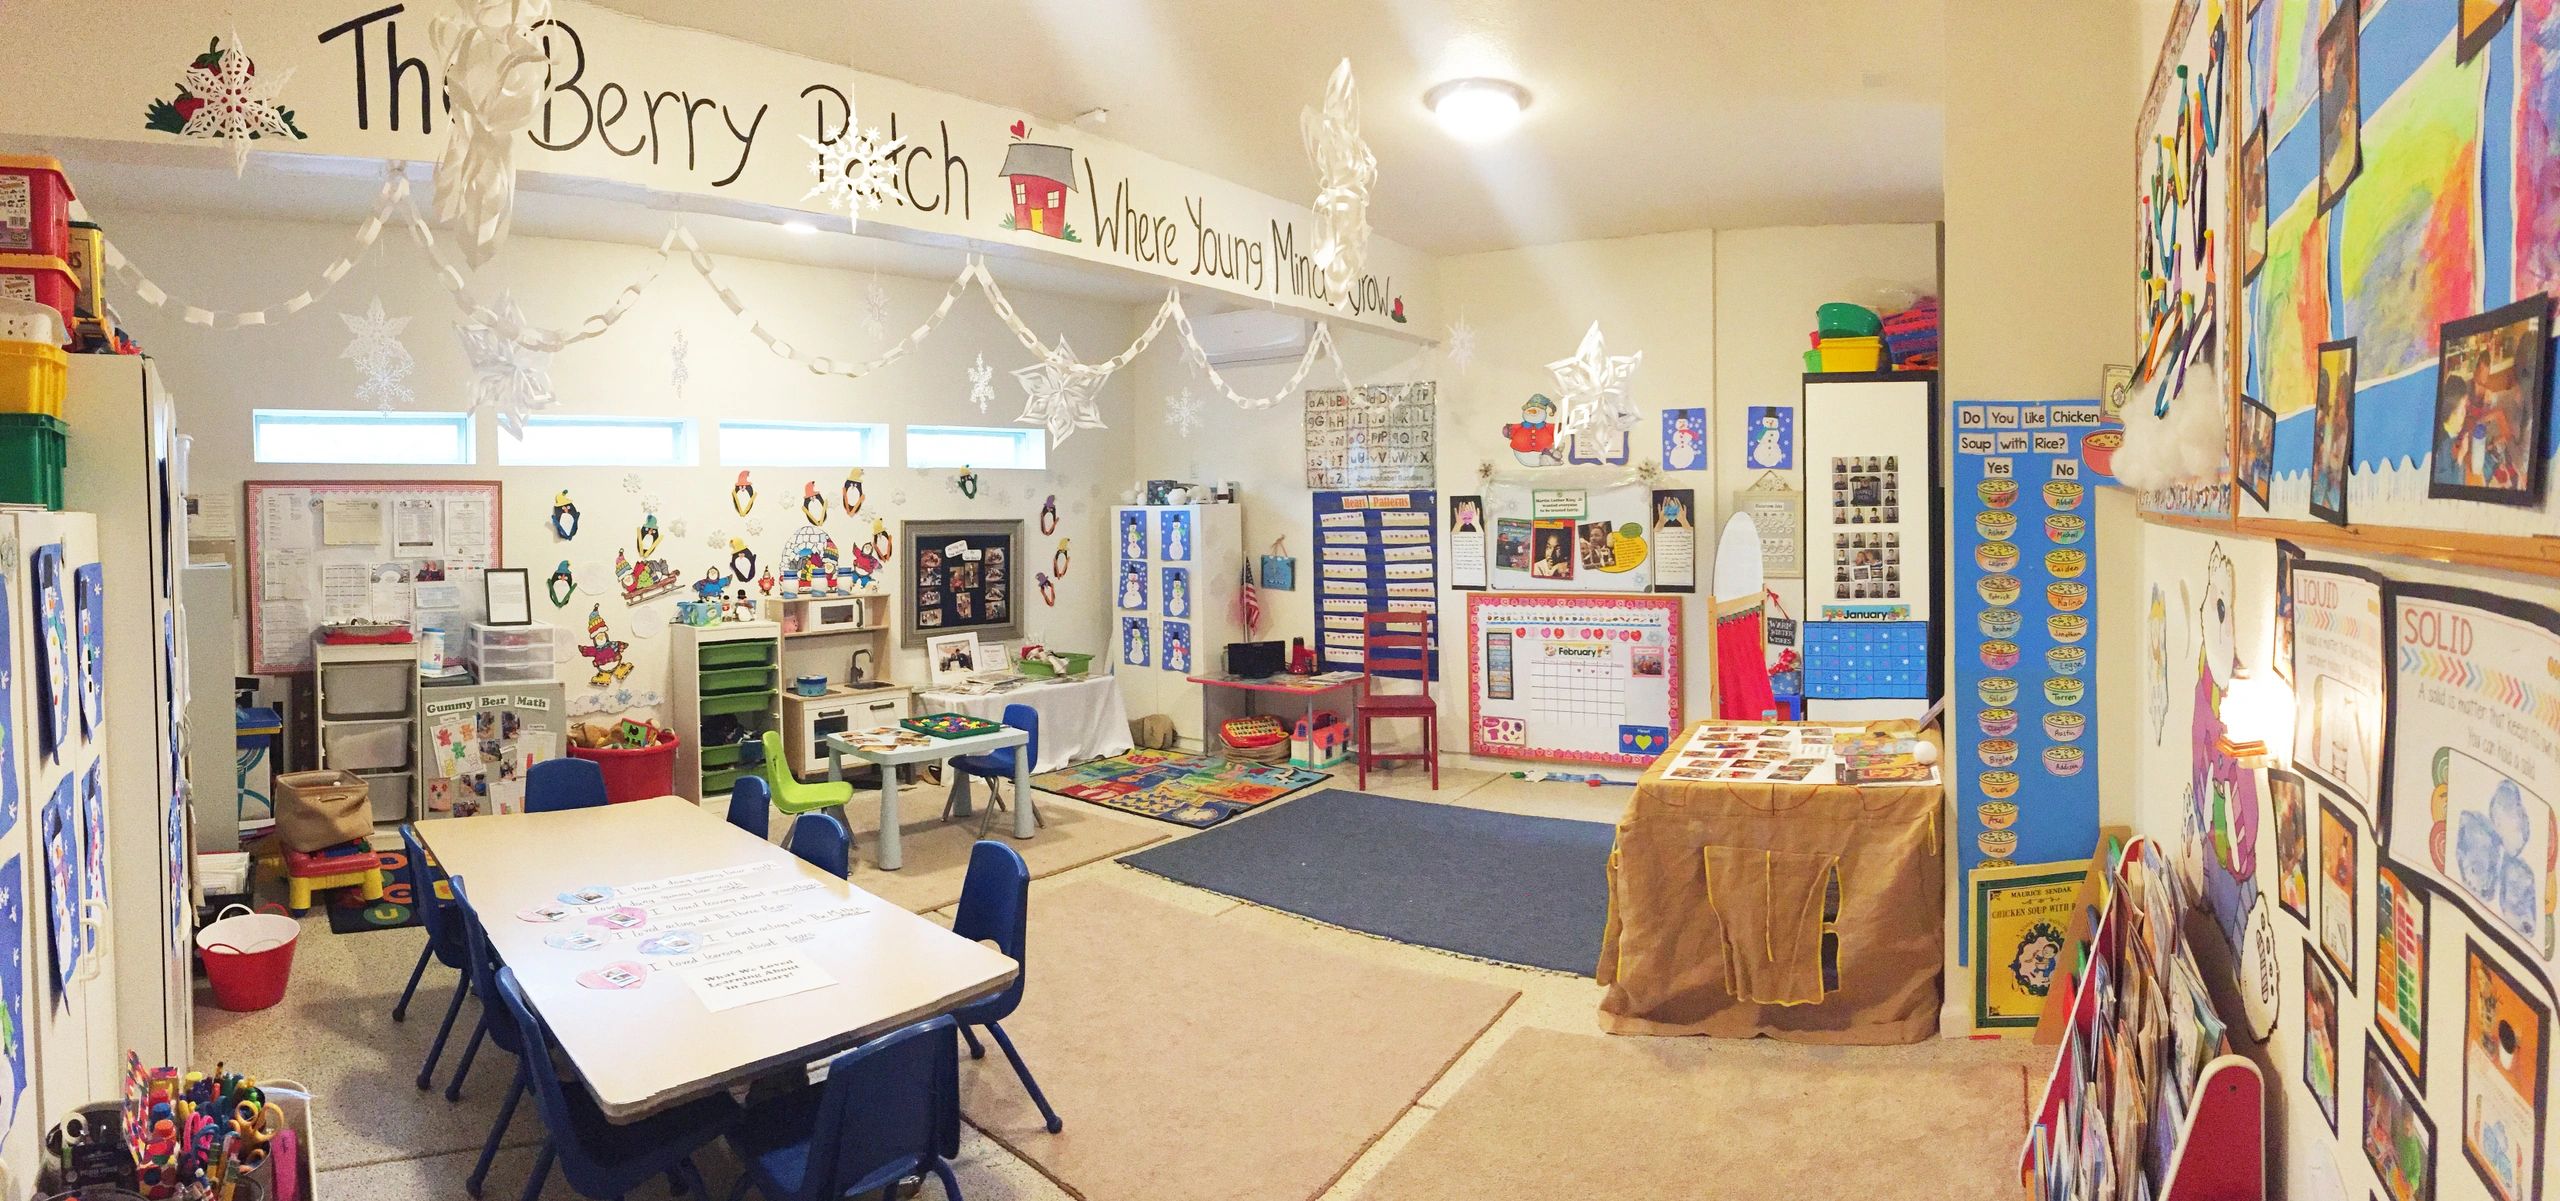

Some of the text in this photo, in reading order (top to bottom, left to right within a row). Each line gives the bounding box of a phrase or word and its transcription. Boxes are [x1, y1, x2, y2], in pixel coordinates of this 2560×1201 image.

[318, 3, 456, 134] Th
[527, 18, 768, 187] Berry
[1085, 157, 1178, 265] Where
[1185, 196, 1263, 290] Young
[1272, 219, 1335, 306] Mind
[1963, 410, 2099, 424] Do You Like Chicken
[1961, 437, 2065, 452] Soup with Rice?
[1987, 462, 2010, 474] Yes
[2056, 464, 2074, 476] No
[2296, 578, 2339, 609] LIQUID
[1843, 609, 1888, 621] January
[2404, 607, 2474, 656] SOLID
[1558, 647, 1597, 658] February
[426, 696, 546, 714] Gummy Bear Math
[2011, 886, 2072, 898] MAURICE SENDAK
[1991, 908, 2025, 919] CHICKEN
[2028, 905, 2047, 915] SOUP
[2049, 903, 2069, 913] WITH
[704, 959, 795, 983] What We Loved
[708, 964, 800, 988] Learning About
